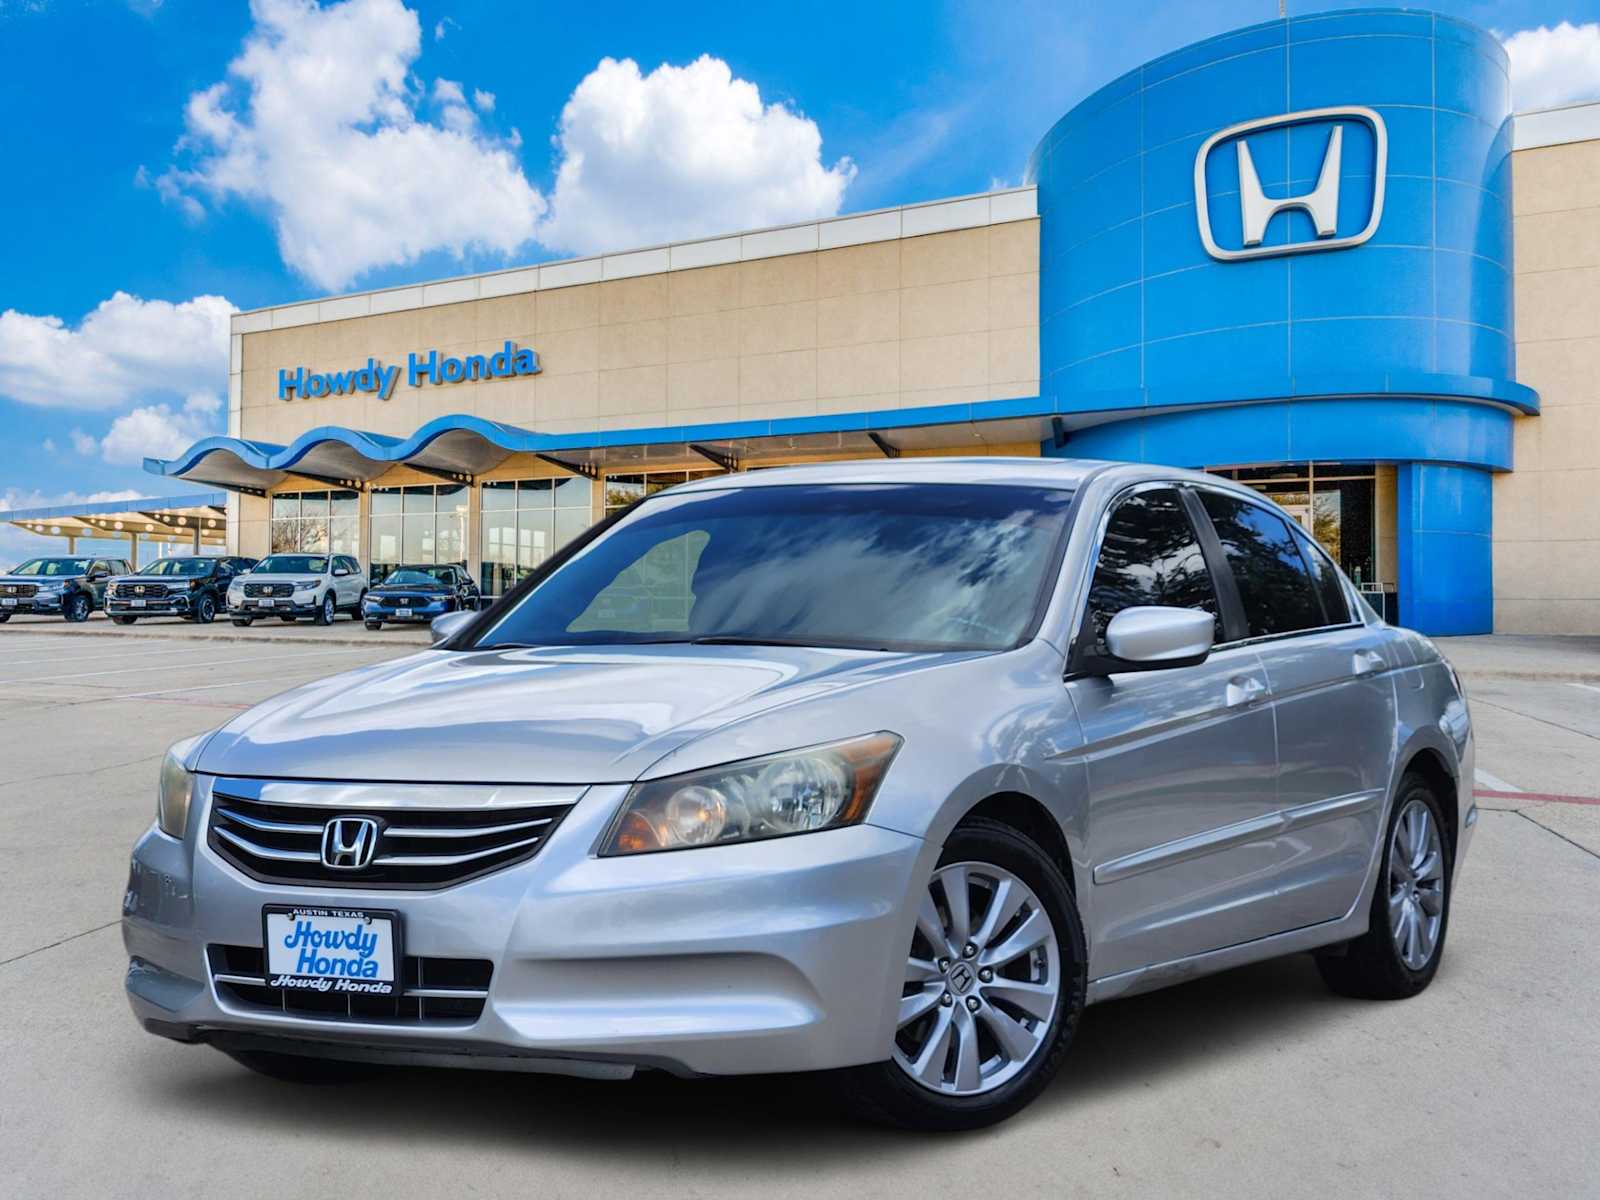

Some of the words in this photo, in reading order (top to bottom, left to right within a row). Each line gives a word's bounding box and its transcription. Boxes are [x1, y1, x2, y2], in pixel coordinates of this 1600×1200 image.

[278, 357, 401, 401] Howdy
[408, 340, 541, 387] Honda
[292, 908, 328, 916] AUSTIN
[332, 910, 365, 918] TEXAS
[284, 920, 378, 958] Howdy
[296, 948, 379, 978] Honda
[270, 975, 332, 992] Howdy
[335, 978, 393, 994] Honda
